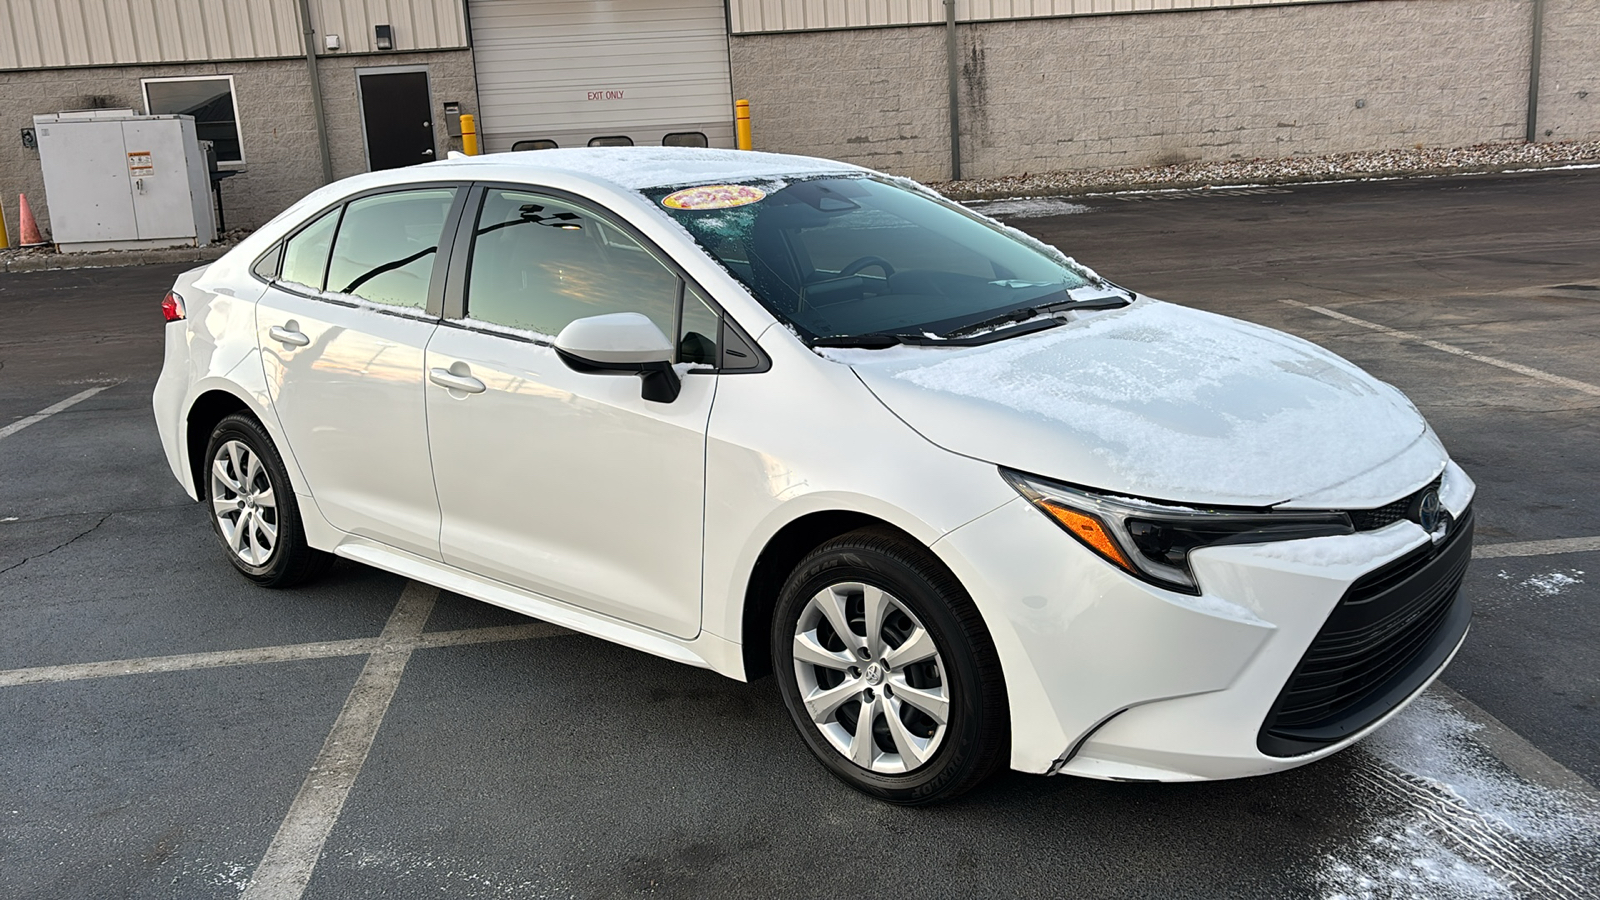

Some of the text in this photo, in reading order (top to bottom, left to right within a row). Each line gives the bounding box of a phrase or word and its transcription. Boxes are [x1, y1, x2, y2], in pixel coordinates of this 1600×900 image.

[587, 90, 624, 100] EXIT ONLY
[911, 754, 965, 799] DUNLOP
